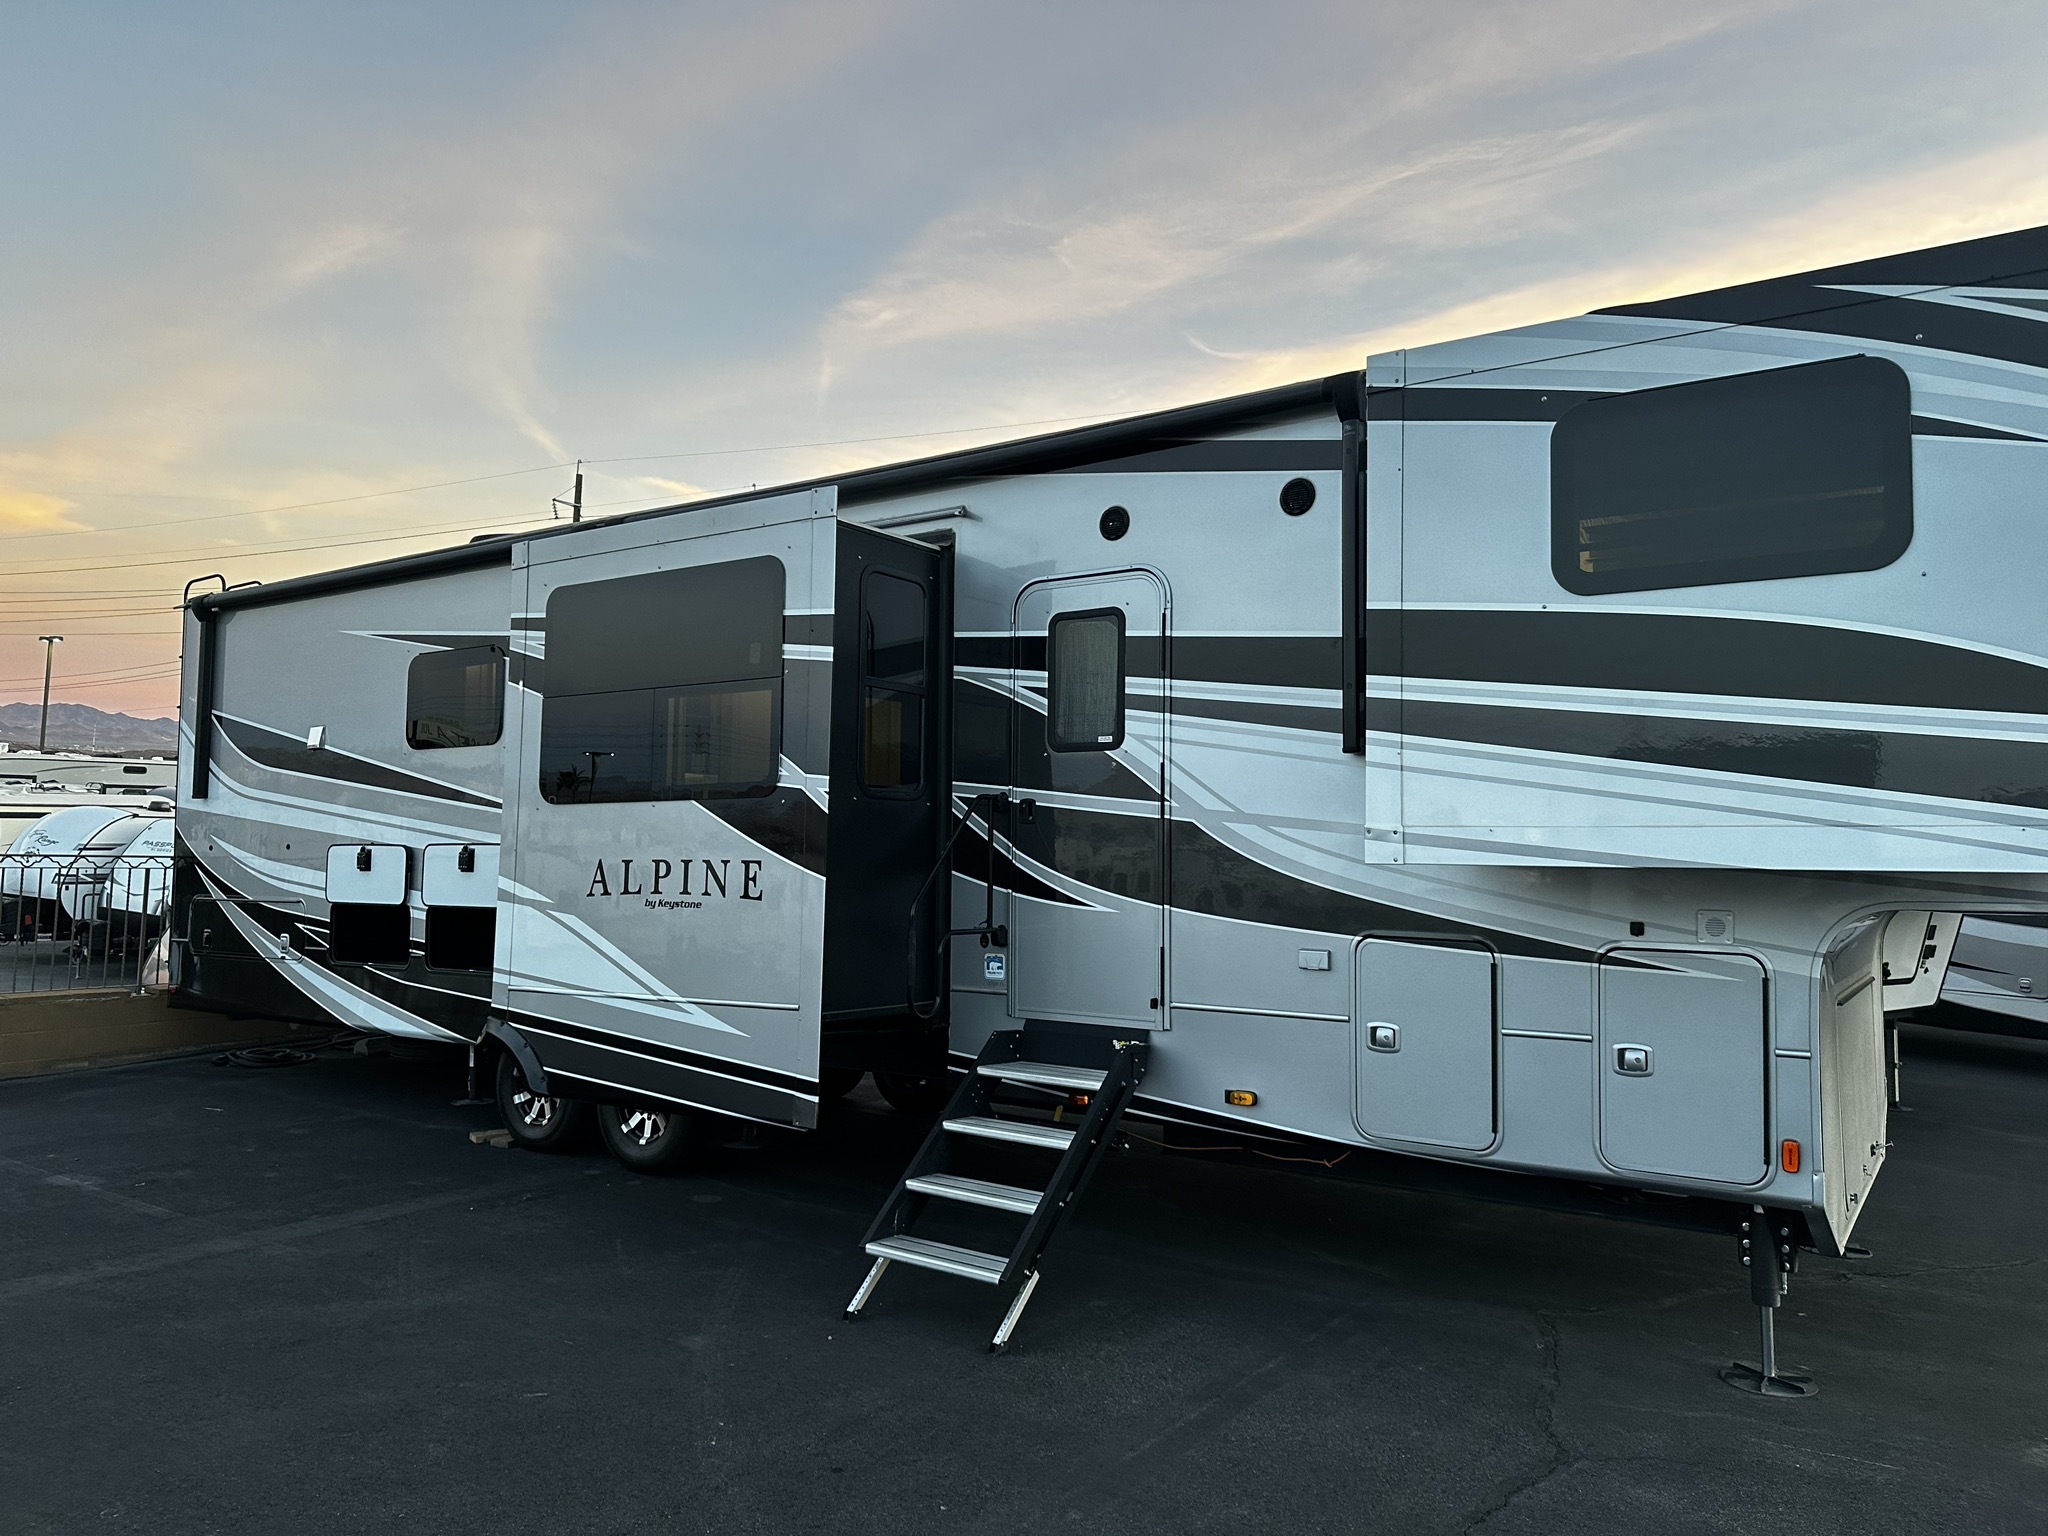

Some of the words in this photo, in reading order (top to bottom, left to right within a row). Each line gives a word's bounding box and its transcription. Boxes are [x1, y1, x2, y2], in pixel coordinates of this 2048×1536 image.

[586, 858, 764, 901] ALPINE
[644, 898, 657, 909] by
[658, 899, 702, 909] Keystone
